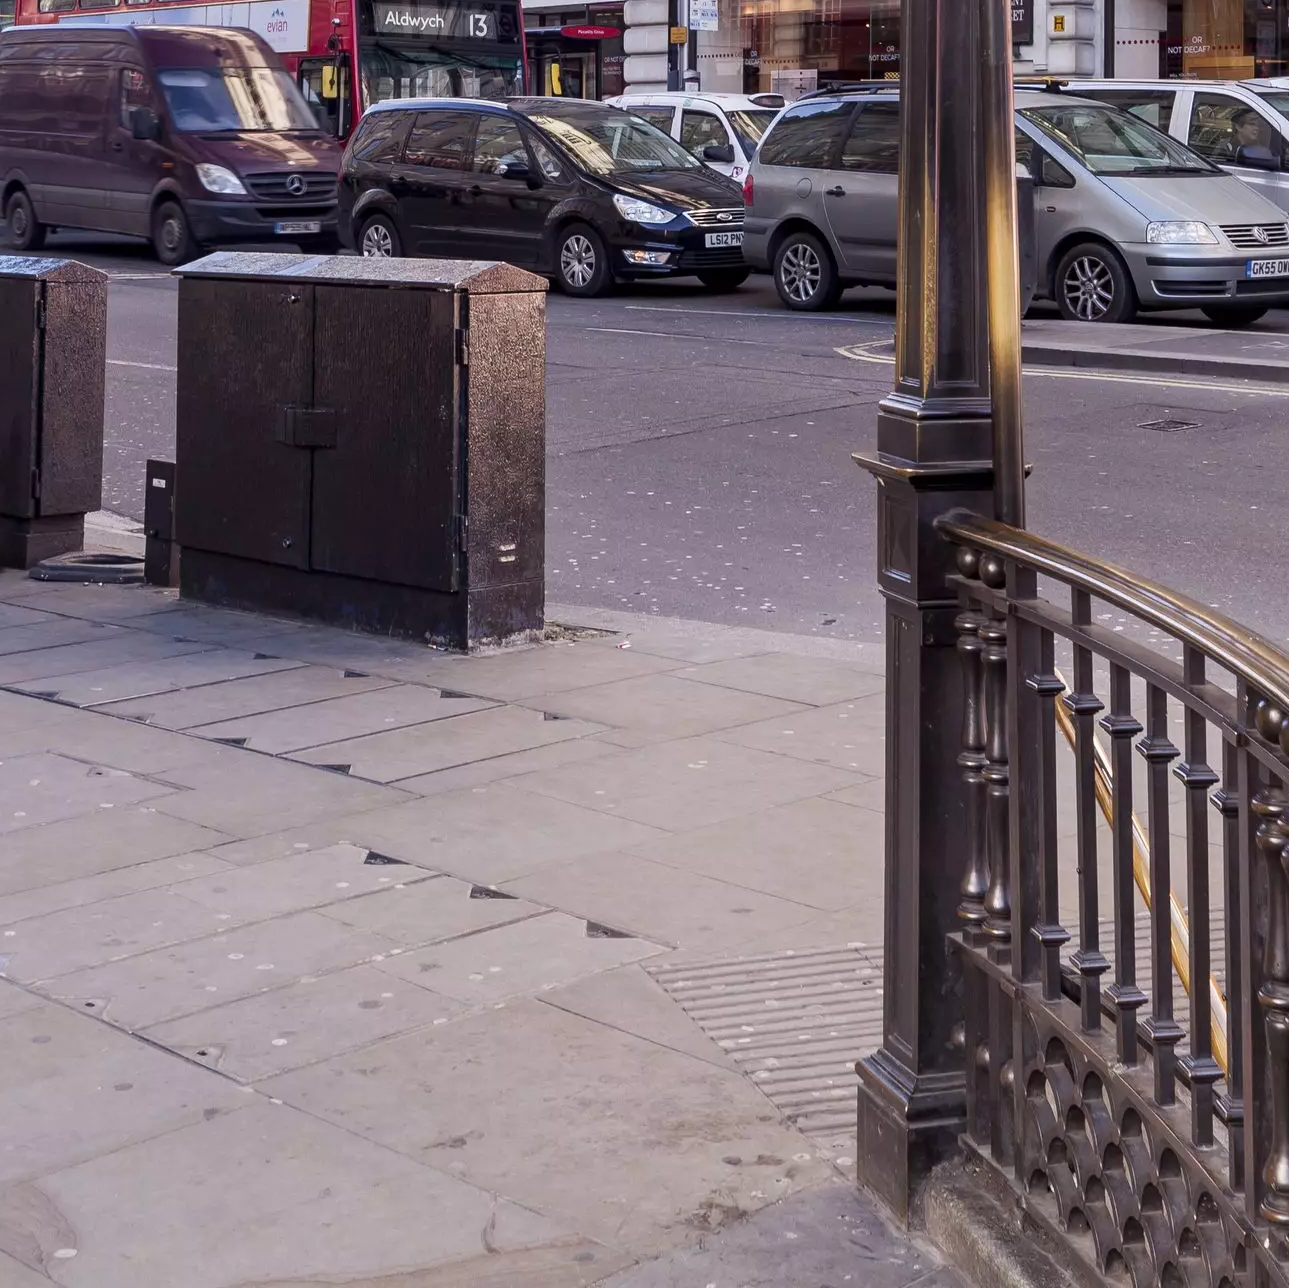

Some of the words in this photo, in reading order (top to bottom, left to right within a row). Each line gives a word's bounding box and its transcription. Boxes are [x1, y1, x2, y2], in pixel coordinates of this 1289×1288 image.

[267, 19, 288, 33] evian
[384, 10, 444, 31] Aldwych
[469, 14, 488, 37] 13
[1191, 35, 1203, 44] OR
[886, 45, 895, 53] OR
[1168, 46, 1182, 54] NOT
[1183, 46, 1211, 54] DECAF?
[869, 54, 880, 62] NOT
[710, 234, 729, 245] LS12
[1253, 262, 1276, 275] GK55
